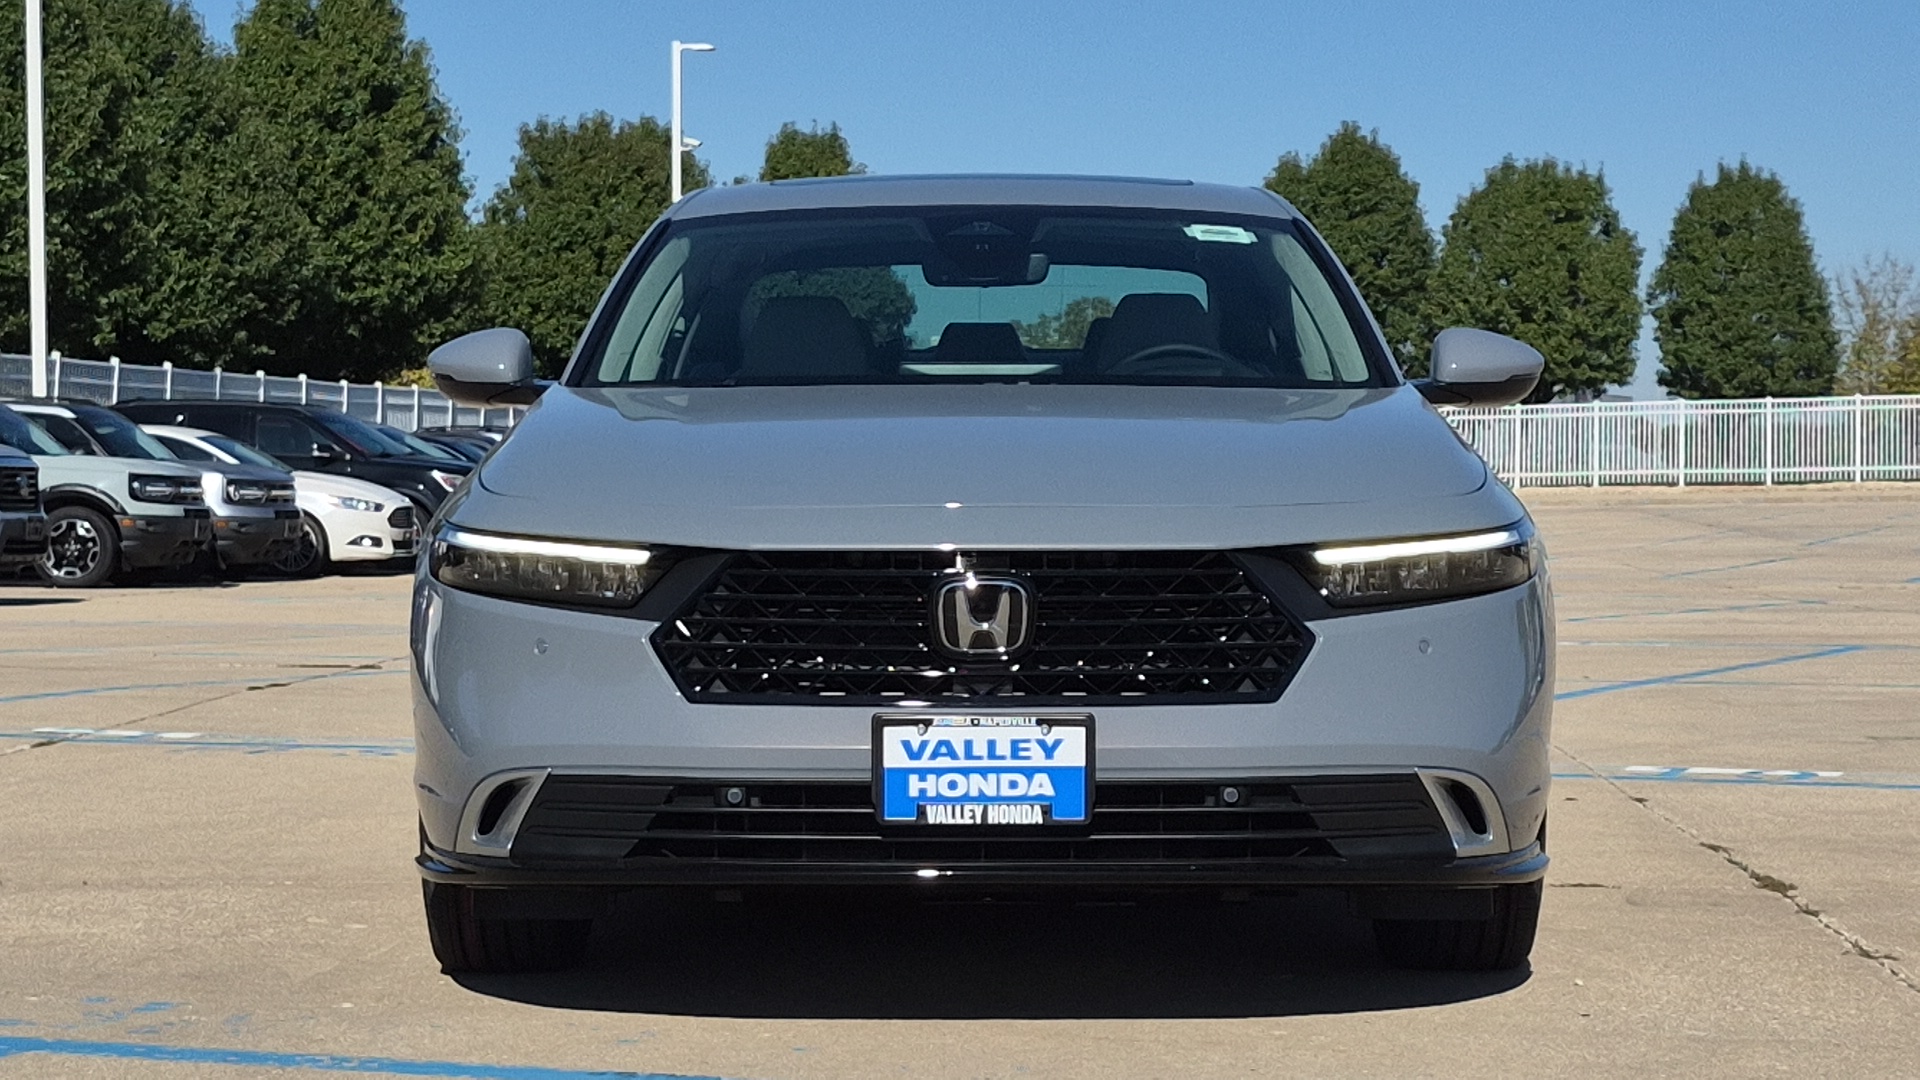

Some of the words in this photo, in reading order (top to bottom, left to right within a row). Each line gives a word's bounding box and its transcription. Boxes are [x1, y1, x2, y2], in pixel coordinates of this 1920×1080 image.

[900, 739, 1063, 761] VALLEY
[908, 773, 1055, 797] HONDA
[926, 804, 983, 824] VALLEY
[987, 804, 1043, 824] HONDA
